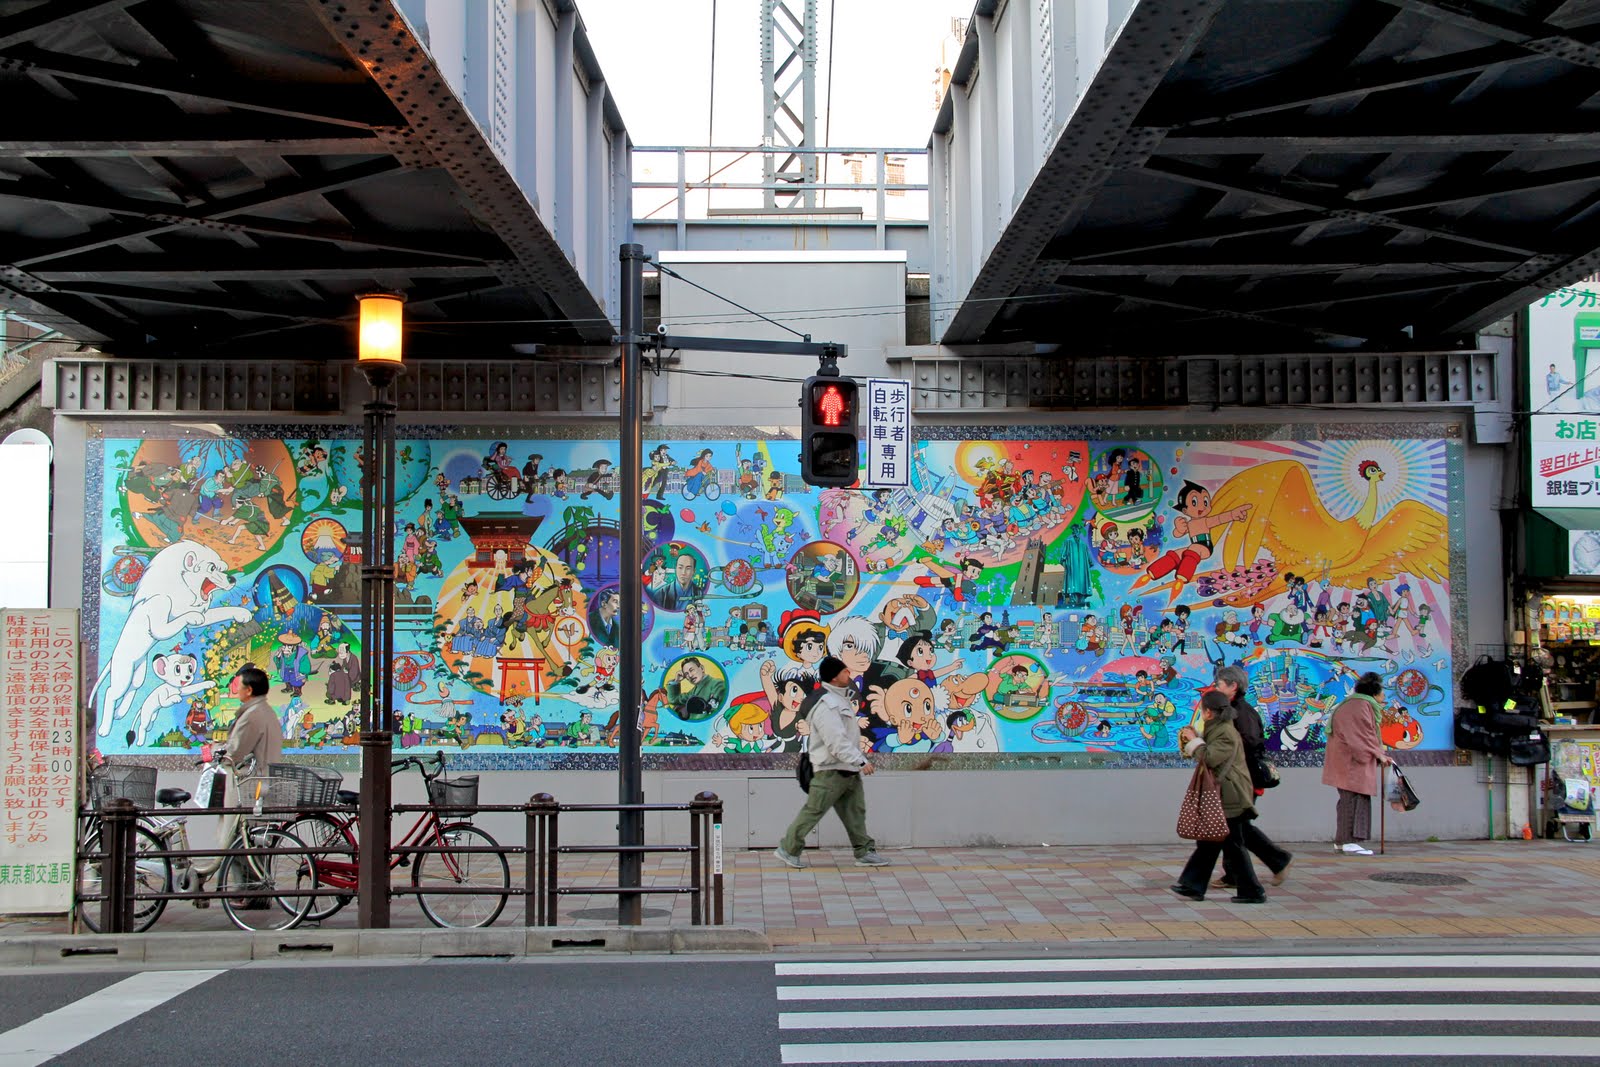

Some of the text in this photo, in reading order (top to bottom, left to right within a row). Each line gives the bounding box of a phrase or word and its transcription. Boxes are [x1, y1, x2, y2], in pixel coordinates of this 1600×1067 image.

[872, 388, 888, 440] 自転車
[890, 388, 905, 442] 歩行者
[1555, 419, 1600, 440] お店
[881, 444, 897, 479] 専用
[0, 862, 71, 885] 東京都交通局
